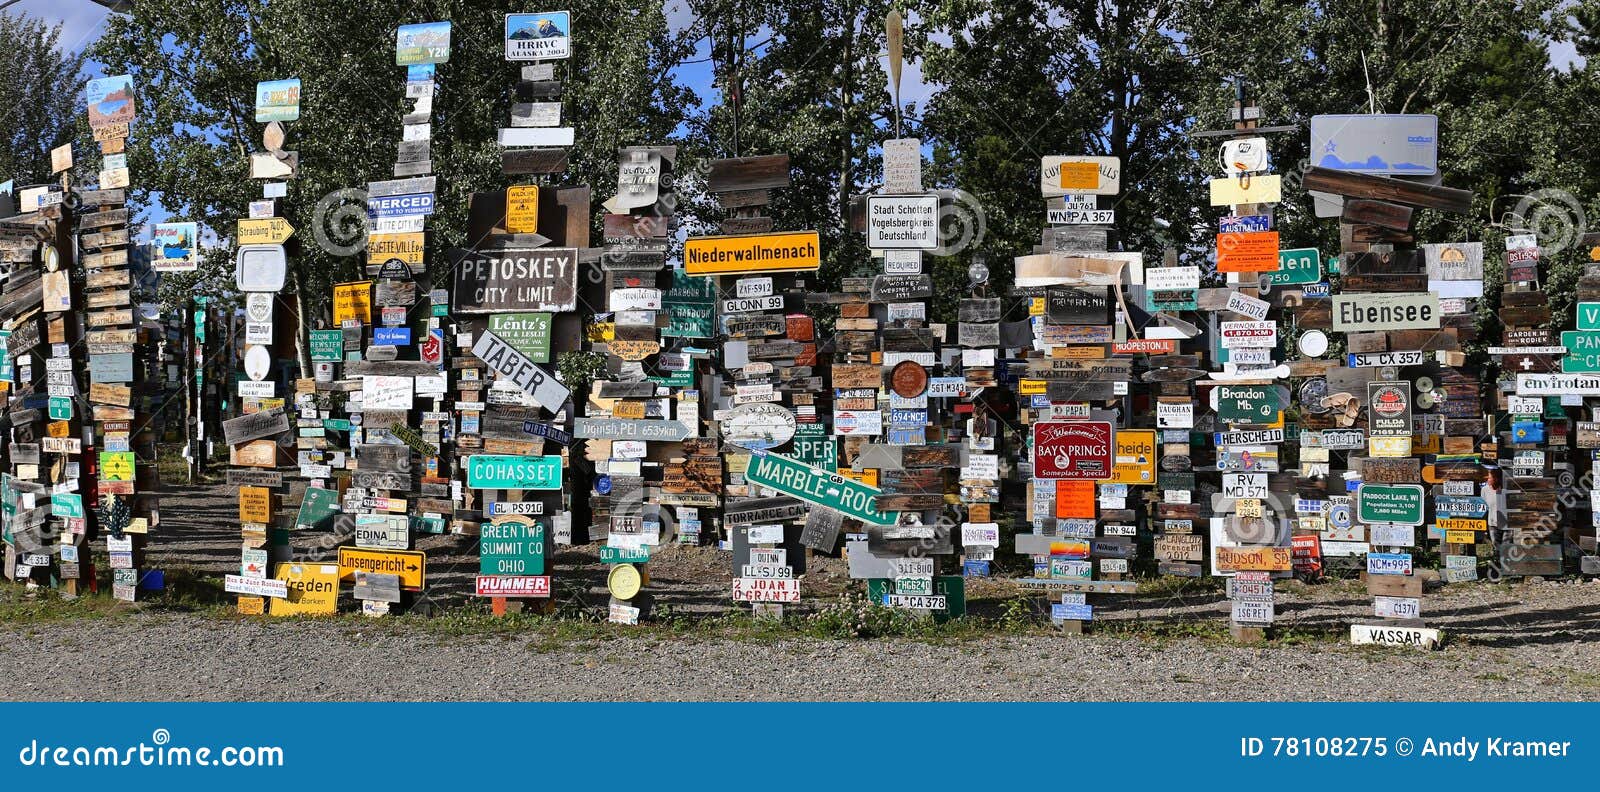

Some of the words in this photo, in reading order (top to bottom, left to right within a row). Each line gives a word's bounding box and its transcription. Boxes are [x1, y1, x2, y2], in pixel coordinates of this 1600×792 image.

[517, 40, 558, 50] HRRVC
[428, 48, 447, 58] Y2K
[369, 197, 430, 209] MERCED
[1080, 202, 1094, 210] 761
[874, 205, 894, 214] Stadt
[898, 205, 932, 214] Schotten
[872, 218, 934, 228] Vogelsbergkreis
[1092, 212, 1112, 222] 367
[240, 226, 269, 238] Straubing
[1226, 224, 1264, 232] AUSTRALIA
[880, 231, 927, 241] Deutschland
[690, 242, 815, 264] Niederwallmenach
[462, 257, 568, 280] PETOSKEY
[475, 288, 508, 303] CITY
[518, 286, 554, 302] LIMIT
[727, 299, 762, 312] GLONN
[768, 298, 780, 308] 99
[1340, 302, 1432, 324] Ebensee
[494, 316, 547, 330] Lentz's
[1356, 354, 1372, 366] SL
[1380, 354, 1396, 365] CX
[1399, 352, 1421, 364] 357
[482, 337, 544, 396] TABER
[1222, 388, 1265, 398] Brandon
[1053, 427, 1095, 439] Welcome
[1223, 430, 1281, 444] HERSCHEID
[1038, 446, 1058, 456] BAY
[475, 464, 554, 480] COHASSET
[756, 459, 828, 498] MARBLE
[830, 476, 844, 484] GB
[1238, 475, 1254, 486] RV
[1226, 487, 1244, 497] MD
[1248, 487, 1267, 497] 571
[1363, 492, 1390, 500] PADDOCK
[494, 504, 506, 513] GL
[512, 504, 524, 513] PS
[526, 504, 543, 512] 910
[1366, 502, 1397, 510] Population
[1477, 504, 1486, 512] PA
[726, 508, 784, 524] TORRANCE
[788, 504, 804, 516] CA
[356, 530, 388, 541] EDINA
[482, 526, 518, 538] GREEN
[522, 526, 544, 538] TWP
[1122, 526, 1135, 534] 944
[482, 542, 522, 555] SUMMIT
[528, 542, 543, 555] CO
[1096, 543, 1118, 552] Nikon
[600, 549, 614, 560] OLD
[620, 548, 648, 558] WILLAPA
[758, 552, 779, 564] QUINN
[1166, 552, 1190, 560] 2012
[1218, 552, 1267, 566] HUDSON,
[1274, 553, 1289, 564] SD
[342, 553, 406, 572] Linsengericht
[498, 560, 525, 572] OHIO
[778, 566, 790, 578] 99
[480, 578, 545, 590] HUMMER
[751, 579, 785, 590] JOAN
[746, 590, 789, 601] GRANT
[910, 596, 922, 608] CA
[926, 596, 945, 608] 378
[1370, 630, 1422, 644] VASSAR
